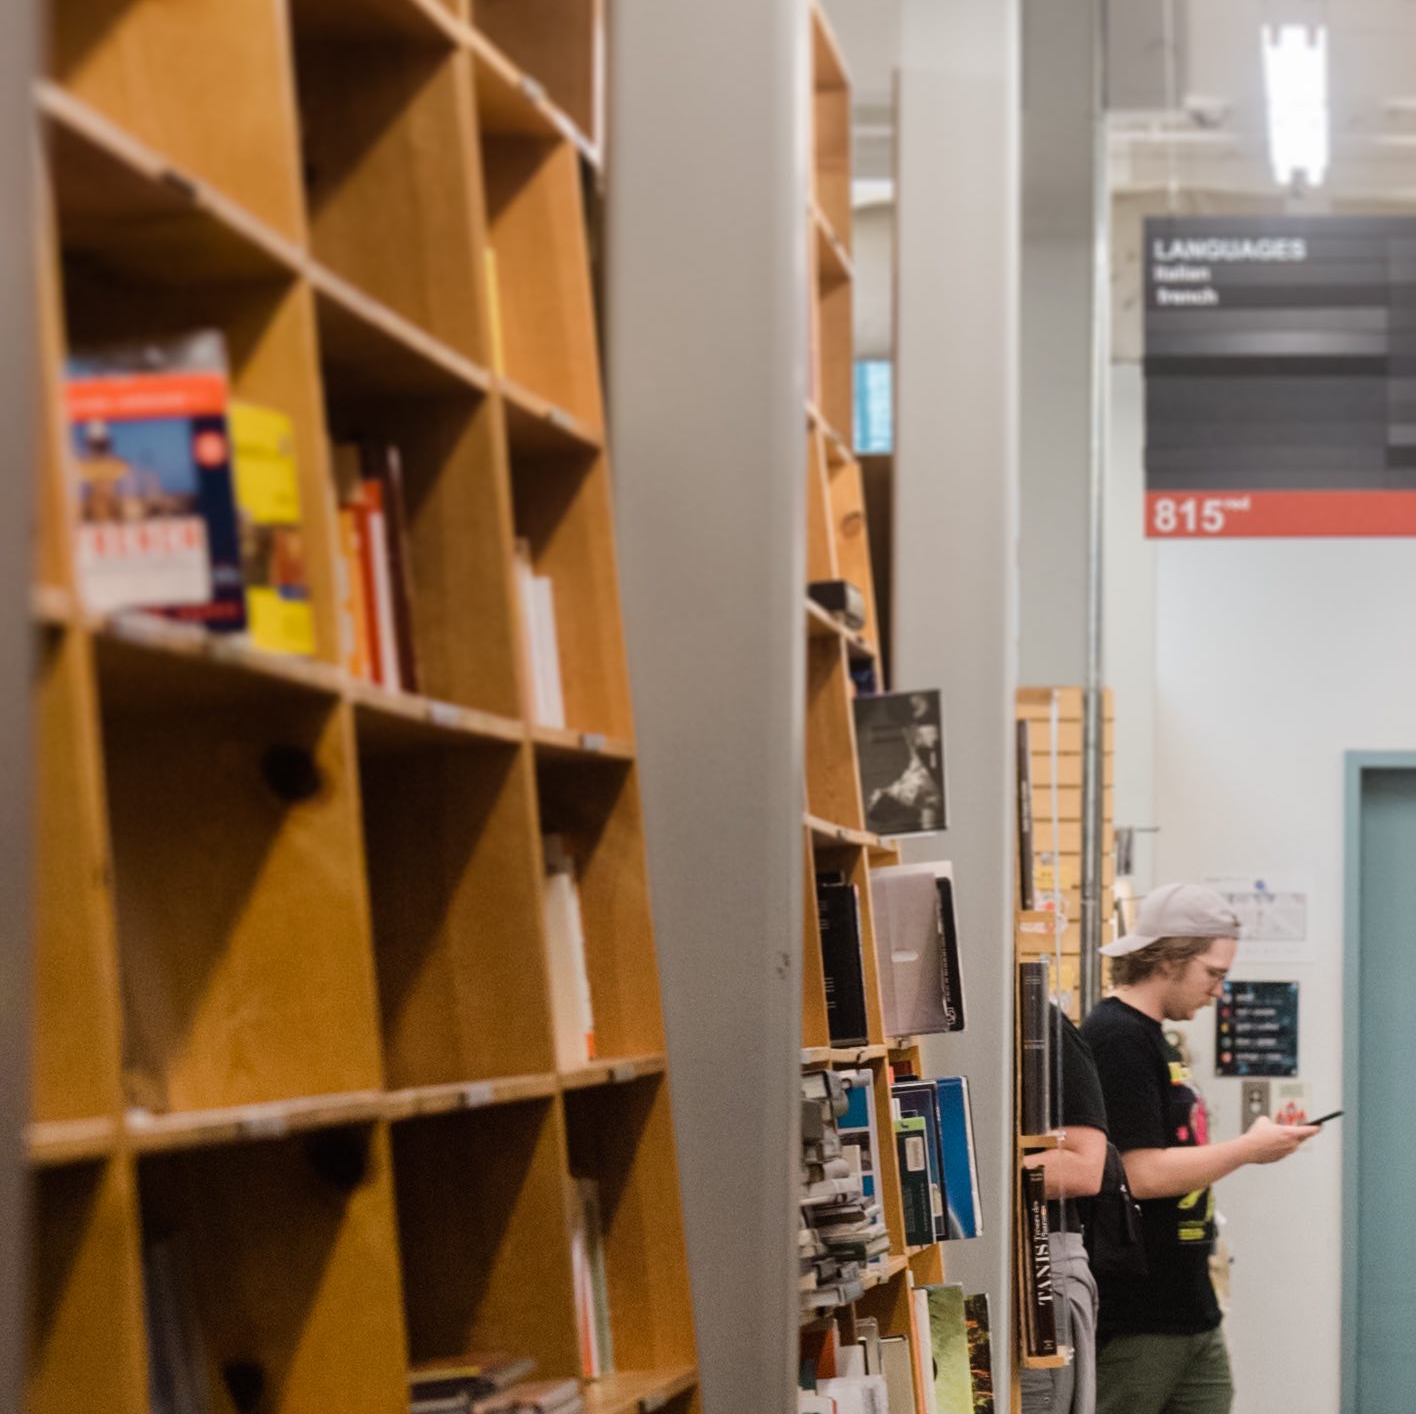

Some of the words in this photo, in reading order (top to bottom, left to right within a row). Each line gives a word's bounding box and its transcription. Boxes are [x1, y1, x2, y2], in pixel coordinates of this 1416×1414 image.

[1153, 238, 1307, 261] LANGUAGES
[1157, 286, 1219, 306] french
[1154, 499, 1225, 532] 815
[1035, 1243, 1053, 1306] TANIS
